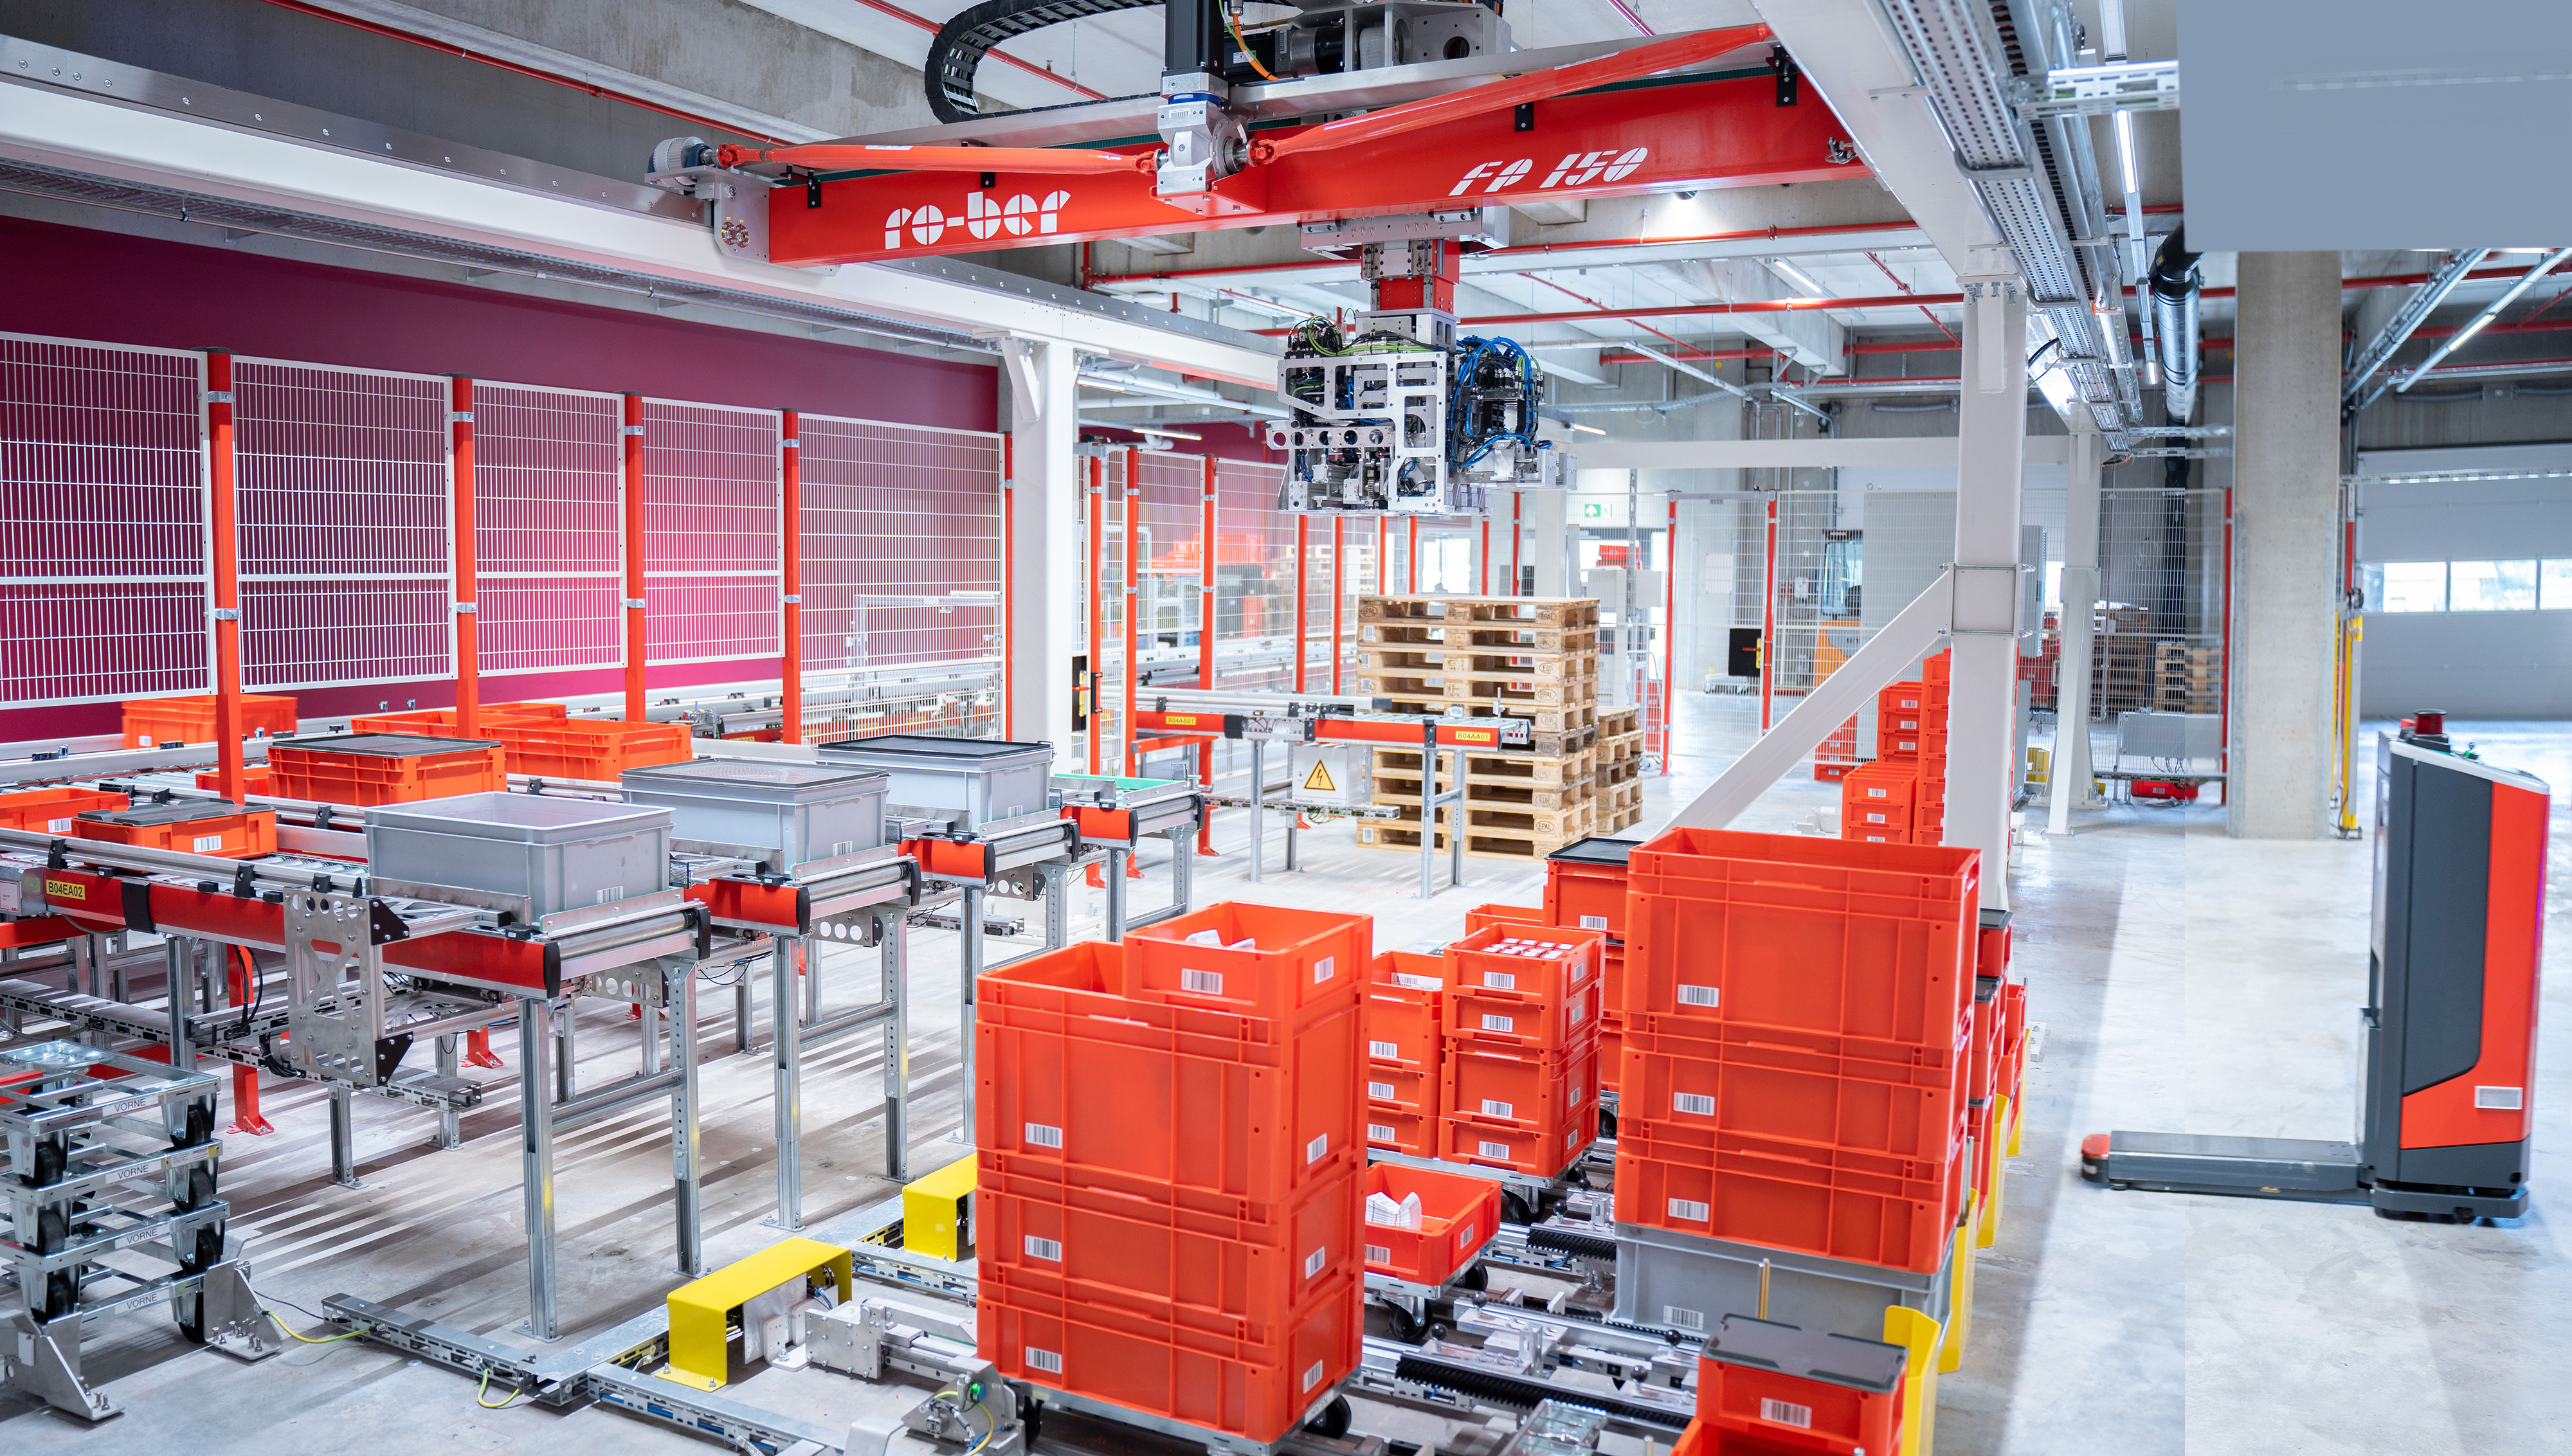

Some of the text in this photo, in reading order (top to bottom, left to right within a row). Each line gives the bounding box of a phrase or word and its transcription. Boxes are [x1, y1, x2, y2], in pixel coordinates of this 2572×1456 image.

[1448, 147, 1649, 196] FP 150
[885, 190, 1071, 250] ro-ber
[48, 881, 83, 897] B04EA02
[114, 1098, 146, 1112] VORNE
[118, 1164, 149, 1179] VORNE
[127, 1228, 158, 1243] VORNE
[127, 1293, 158, 1309] VORNE
